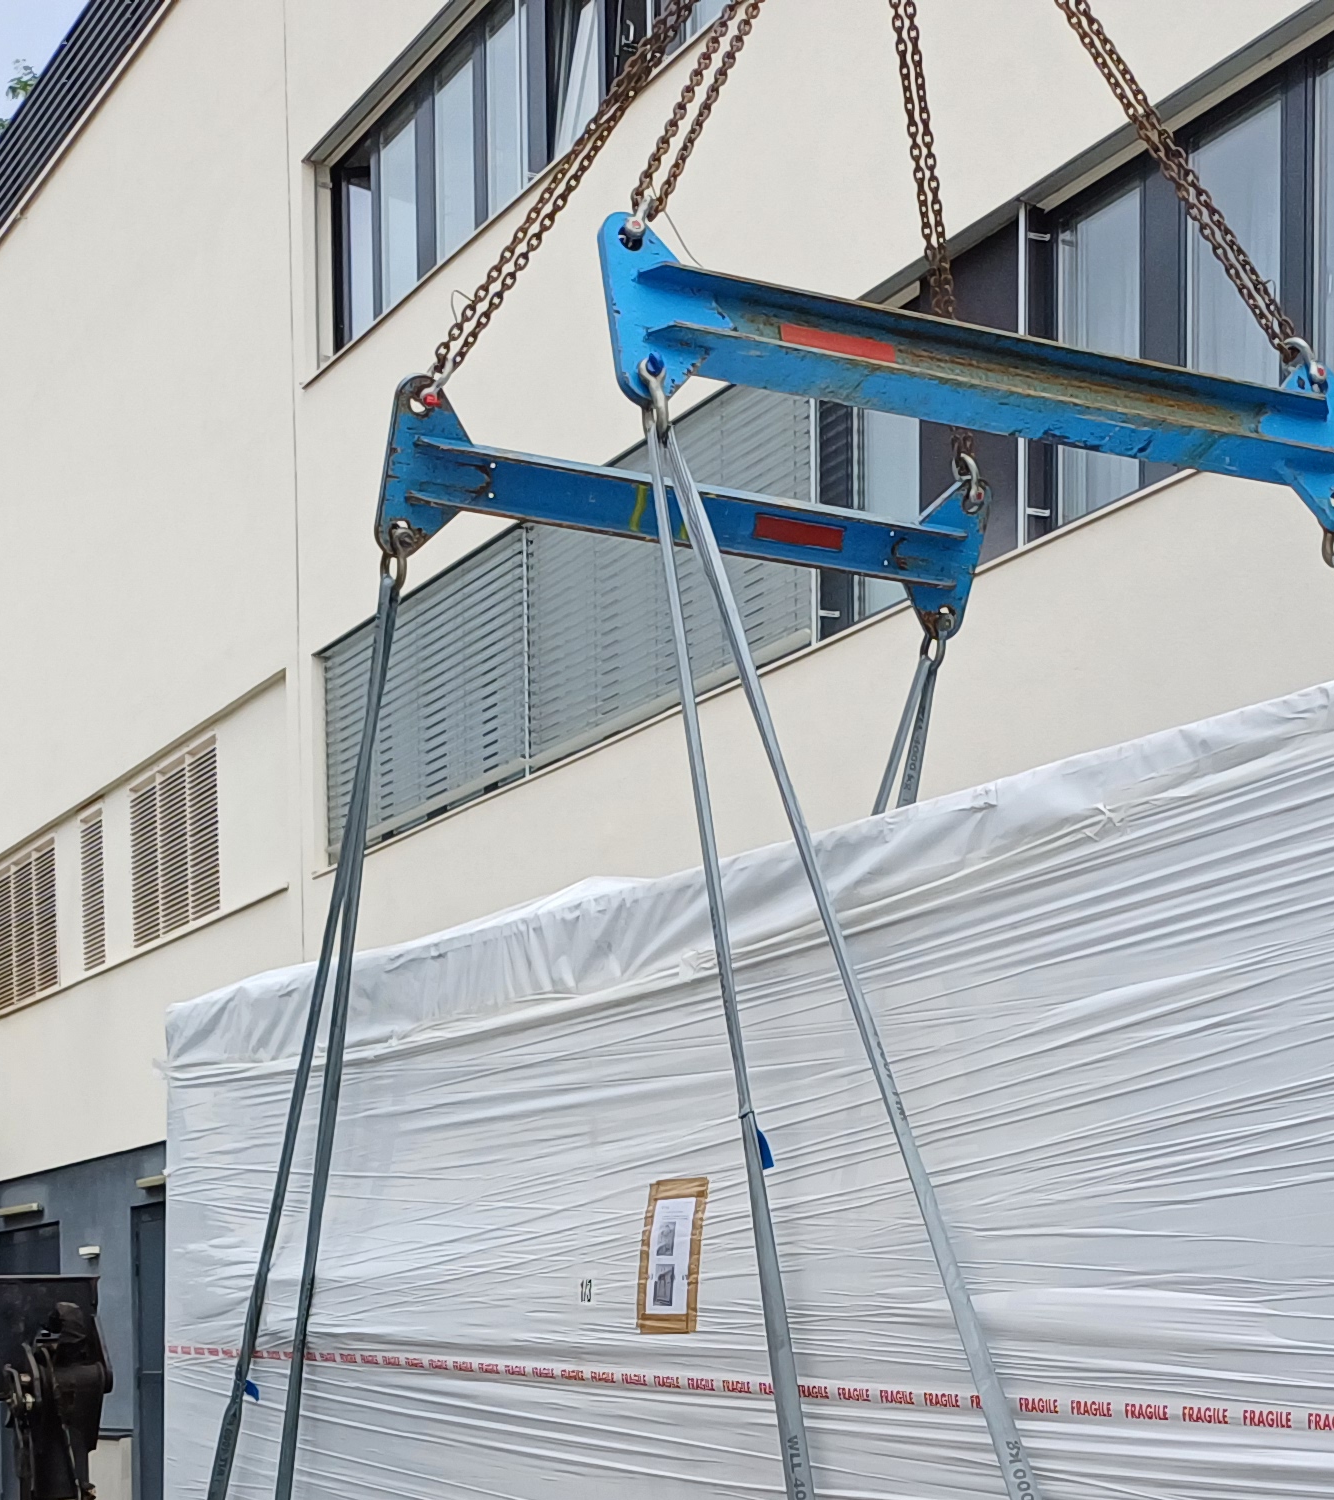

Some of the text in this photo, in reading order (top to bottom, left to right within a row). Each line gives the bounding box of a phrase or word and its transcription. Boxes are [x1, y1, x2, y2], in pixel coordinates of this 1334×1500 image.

[687, 1377, 716, 1391] FRAGILE
[722, 1379, 752, 1393] FRAGILE
[798, 1385, 830, 1399] FRAGILE
[837, 1387, 871, 1402] FRAGILE
[880, 1389, 915, 1405] FRAGILE
[924, 1392, 960, 1408] FRAGILE
[1018, 1397, 1059, 1414] FRAGILE
[1071, 1400, 1112, 1417] FRAGILE
[1124, 1403, 1169, 1421] FRAGILE
[1182, 1406, 1229, 1424] FRAGILE
[1243, 1409, 1292, 1429] FRAGILE
[787, 1435, 802, 1474] WLL
[1006, 1440, 1022, 1465] kg
